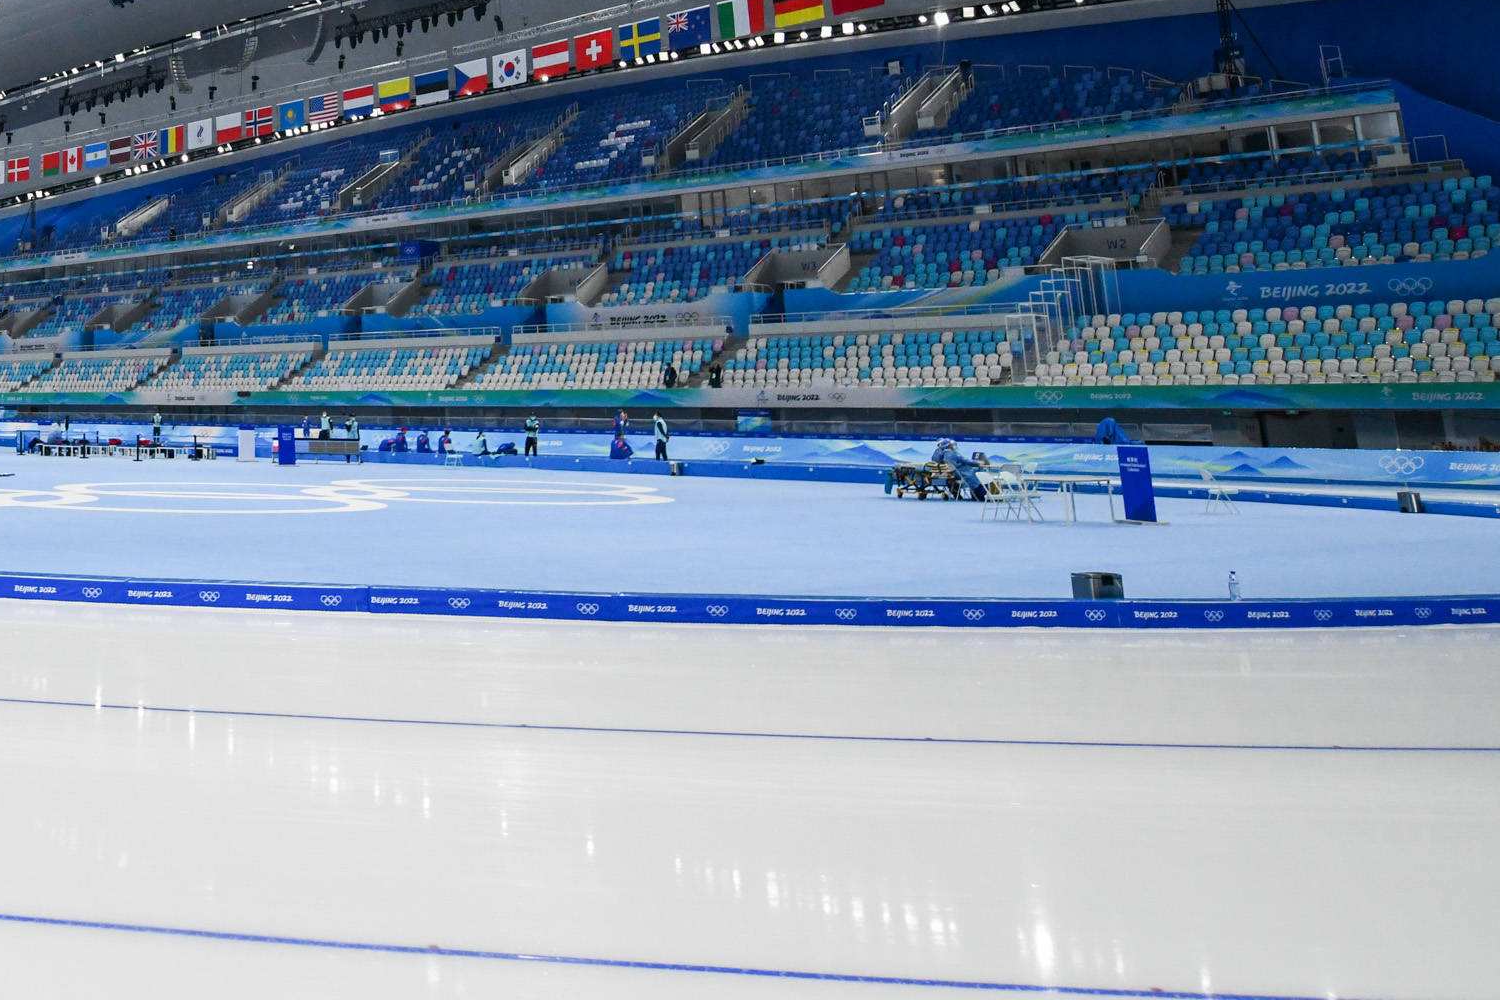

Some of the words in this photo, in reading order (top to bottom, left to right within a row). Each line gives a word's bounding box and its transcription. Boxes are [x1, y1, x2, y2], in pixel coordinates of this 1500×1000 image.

[1260, 285, 1320, 301] BEIJING
[1324, 282, 1372, 296] 2022
[1411, 392, 1452, 402] BEIJING
[1454, 392, 1484, 400] 2022
[14, 584, 37, 594] BEIJING
[128, 589, 152, 599] BEIJING
[246, 593, 271, 602] BEIJING
[272, 594, 293, 602] 2022
[371, 596, 397, 606] BEIJING
[398, 597, 419, 605] 2022
[498, 600, 526, 610] BEIJING
[526, 601, 548, 610] 2022
[628, 604, 656, 614] BEIJING
[755, 607, 784, 617] BEIJING
[785, 608, 807, 616] 2022
[886, 609, 913, 619] BEIJING
[915, 609, 935, 617] 2022
[1011, 610, 1038, 619] BEIJING
[1134, 610, 1158, 620] BEIJING
[1248, 611, 1271, 620] BEIJING
